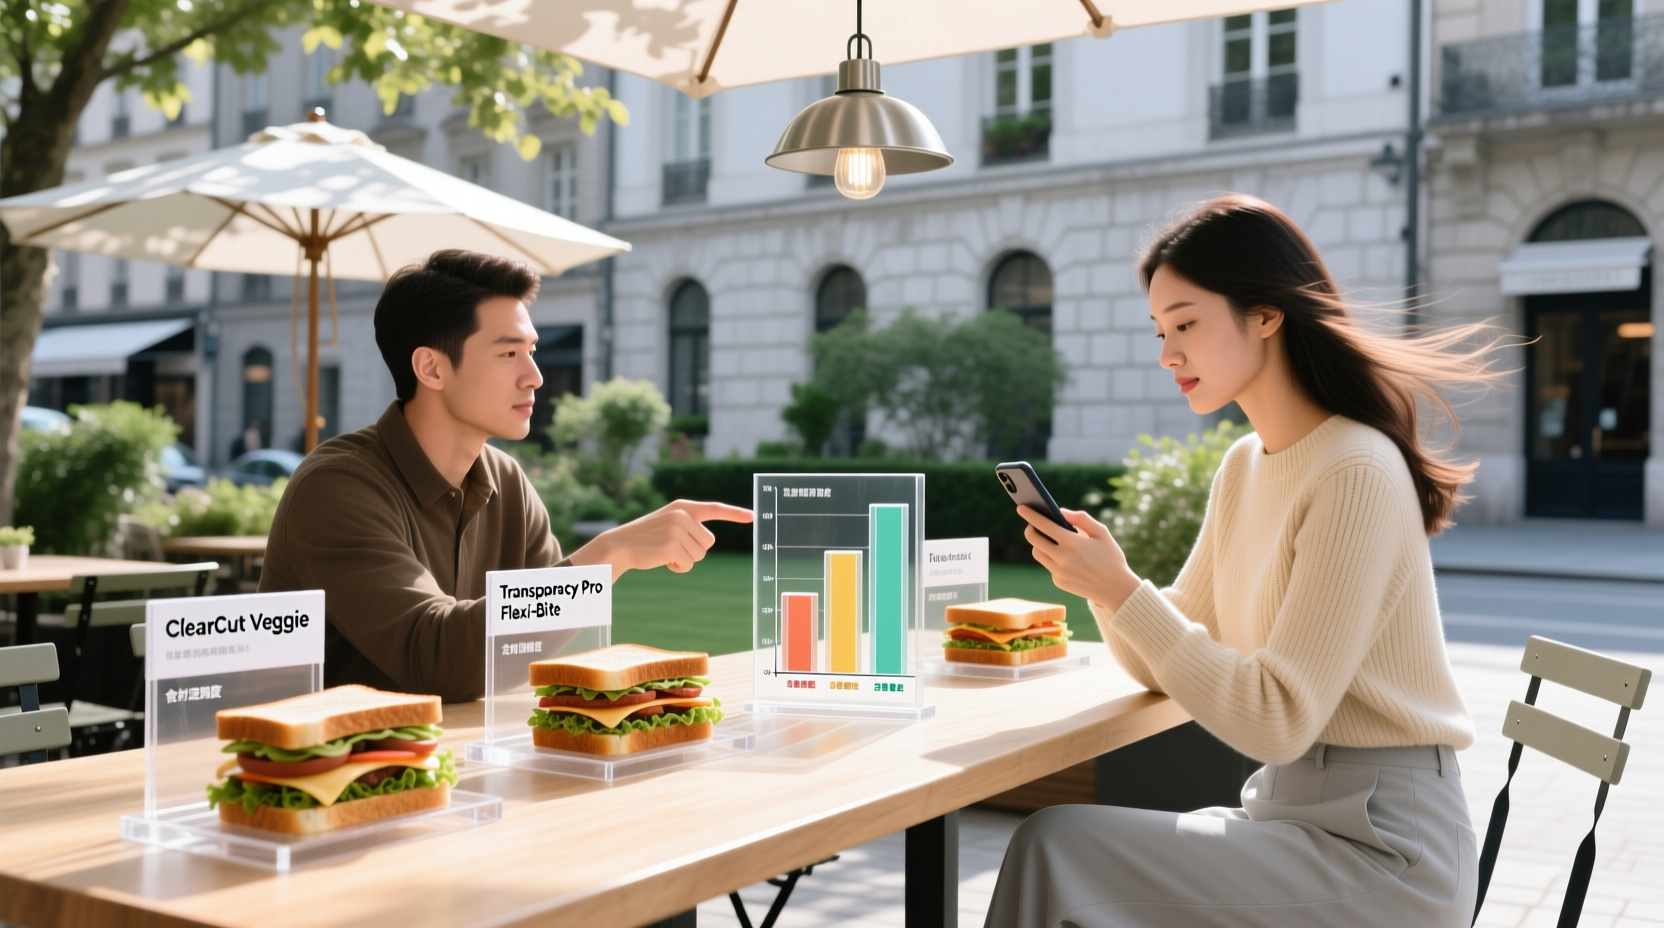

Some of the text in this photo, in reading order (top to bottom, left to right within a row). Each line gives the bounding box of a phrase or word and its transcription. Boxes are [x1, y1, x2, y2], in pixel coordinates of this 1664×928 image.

[581, 579, 603, 595] Pro
[165, 609, 310, 638] ClearCut Veggie
